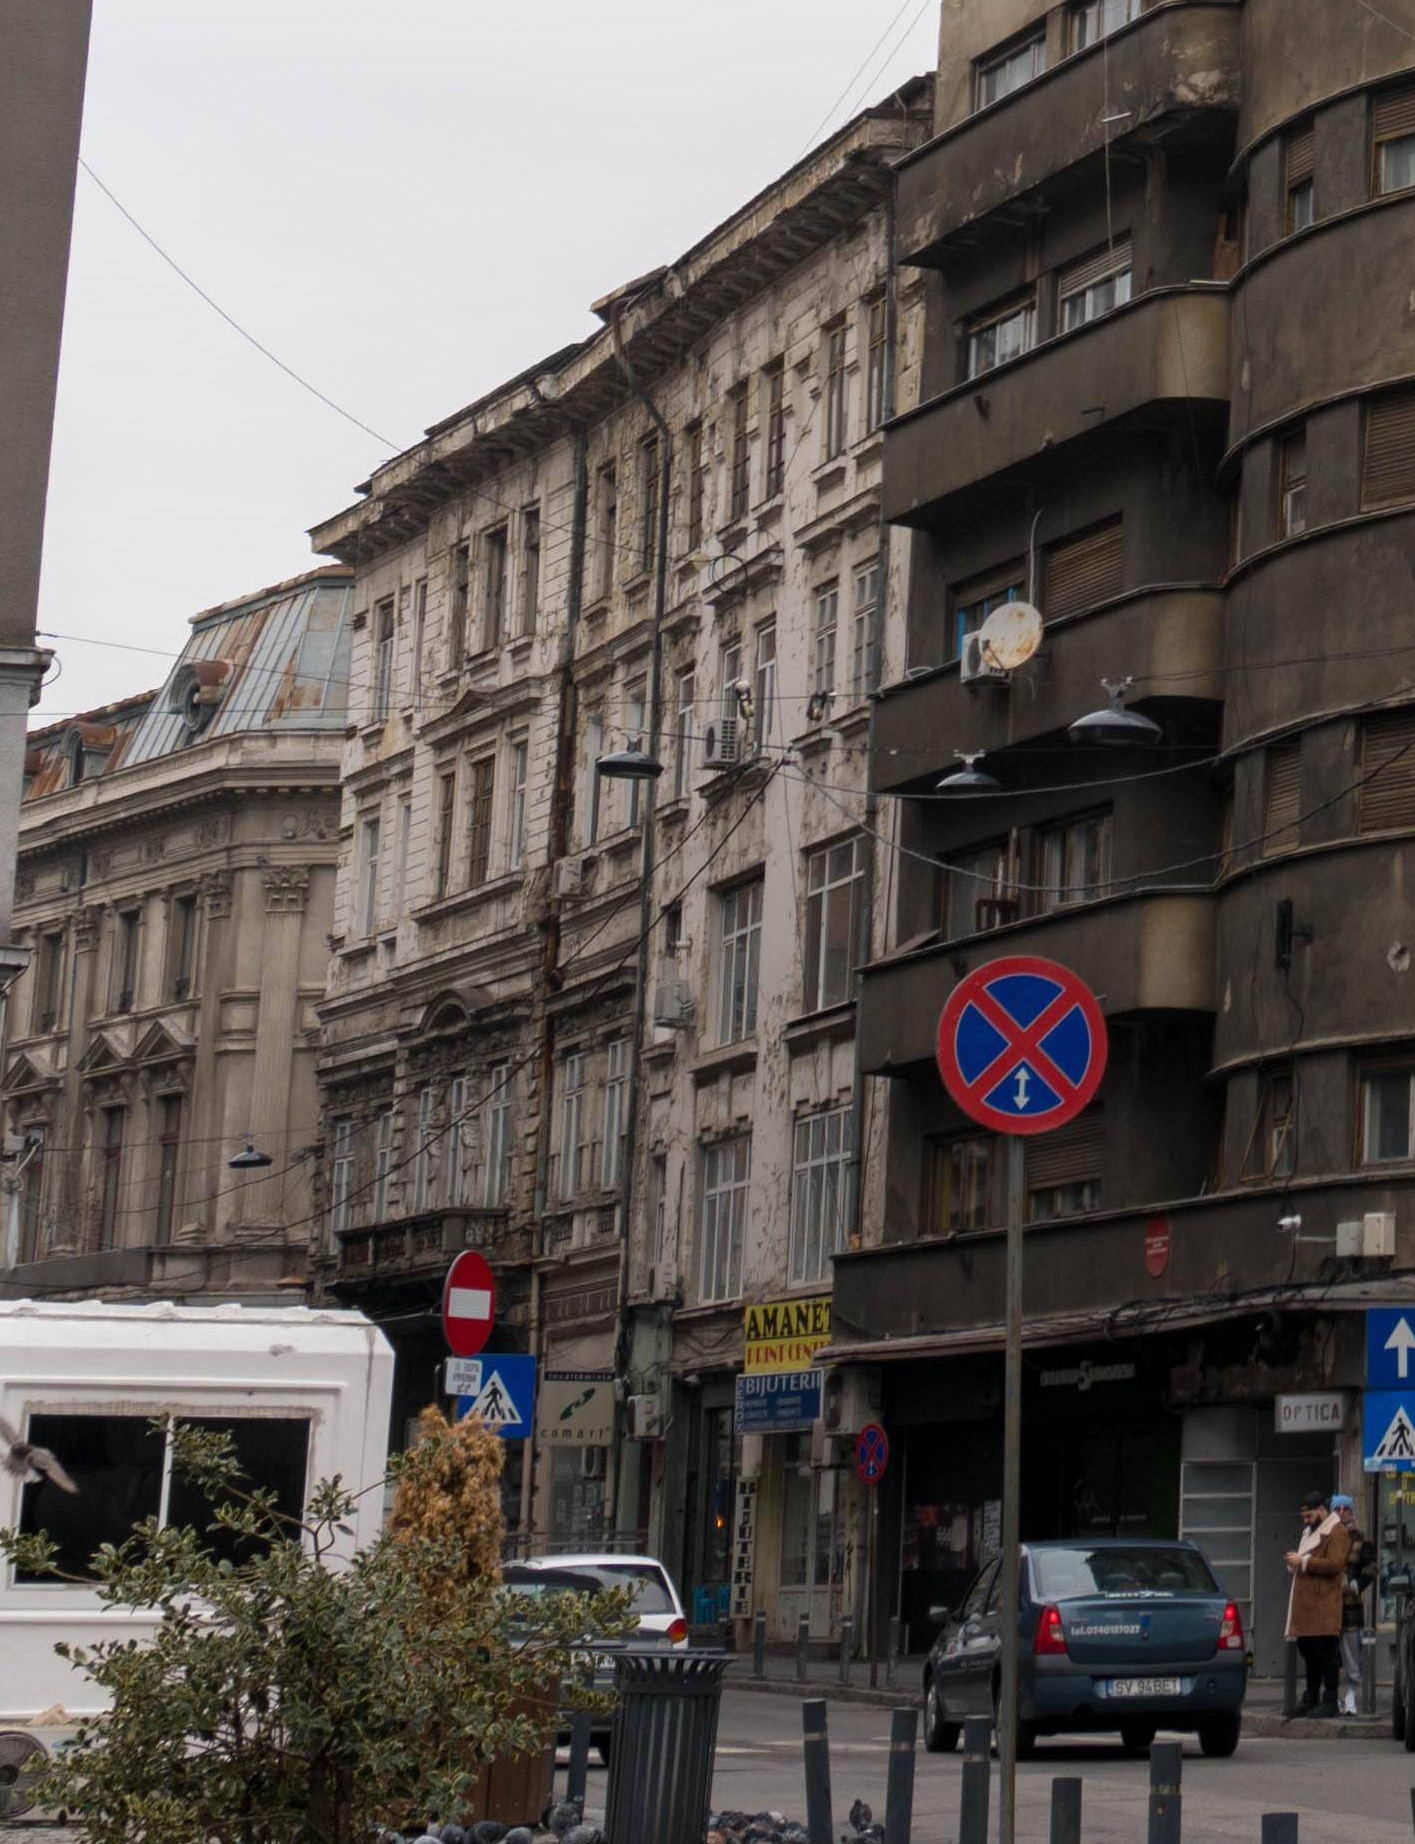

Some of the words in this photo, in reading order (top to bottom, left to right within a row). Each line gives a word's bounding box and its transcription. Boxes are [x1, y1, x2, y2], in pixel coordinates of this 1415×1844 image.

[789, 1340, 832, 1361] CENT
[1283, 1402, 1341, 1423] OPTICA
[1116, 1681, 1132, 1694] SV
